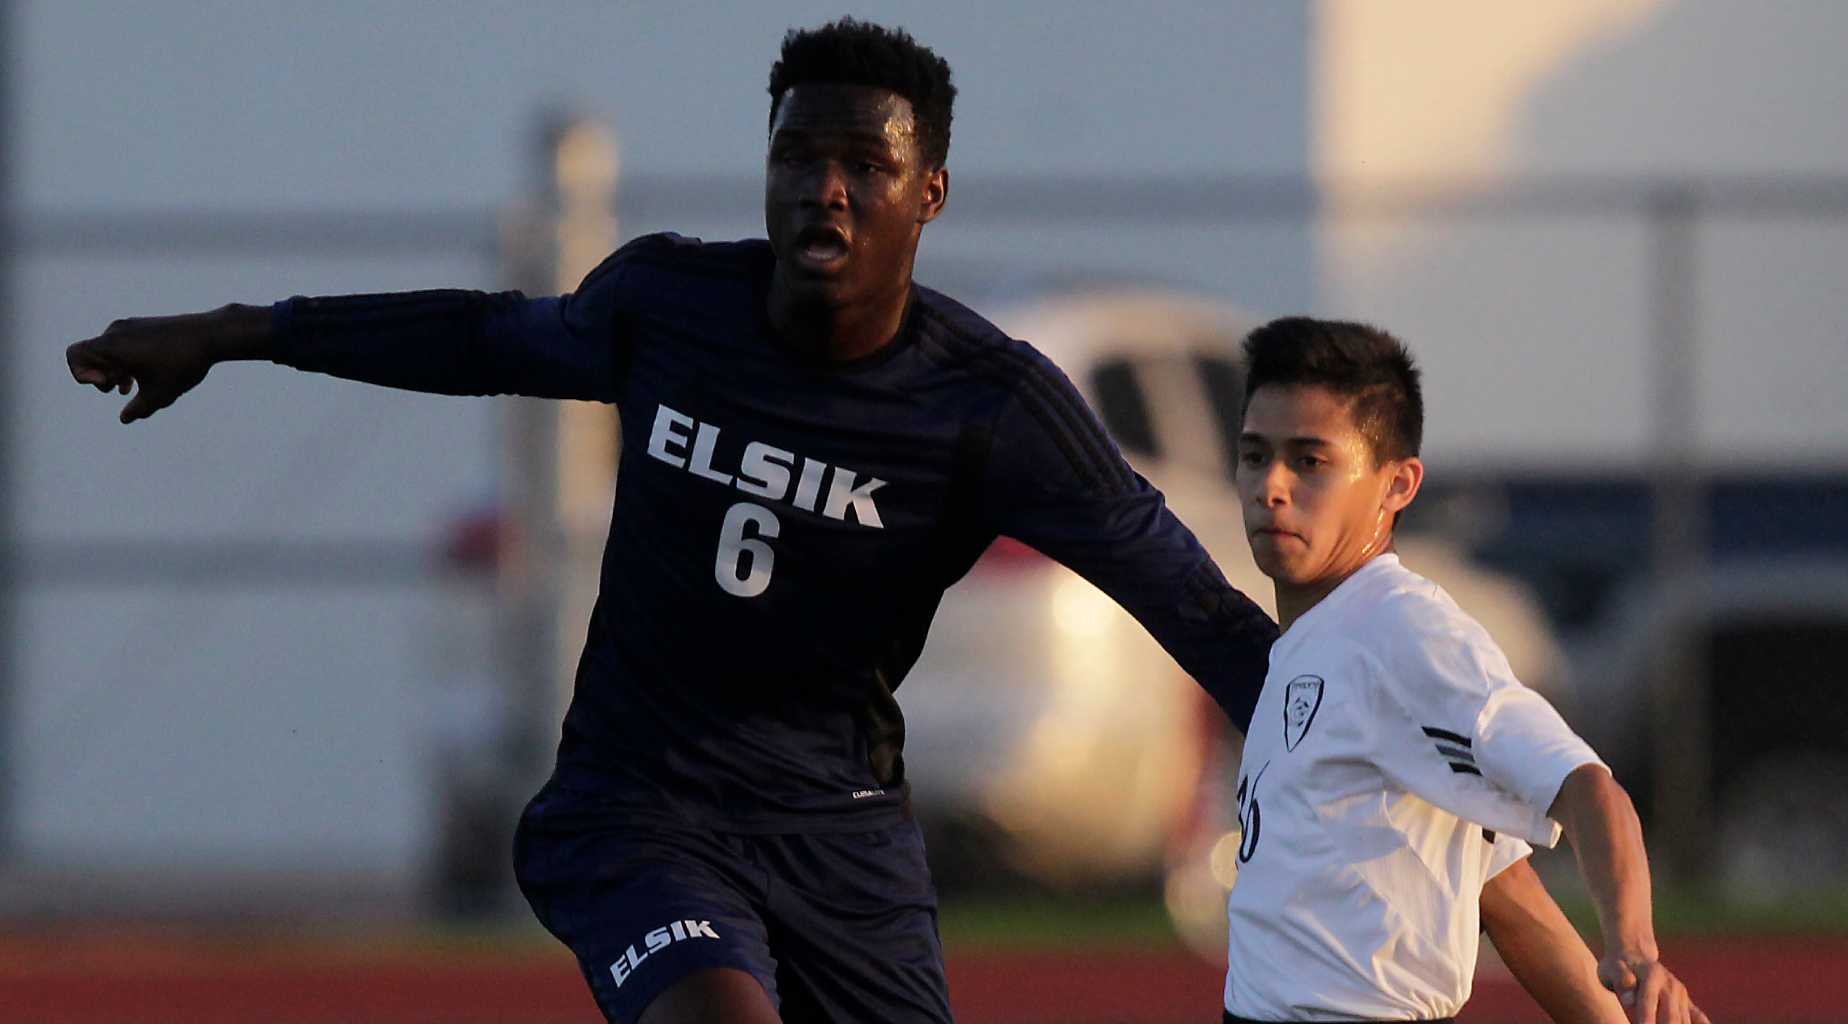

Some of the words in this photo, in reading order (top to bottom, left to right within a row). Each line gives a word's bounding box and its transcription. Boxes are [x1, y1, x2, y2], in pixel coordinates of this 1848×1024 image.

[647, 403, 889, 529] ELSIK
[714, 502, 780, 598] 6
[609, 919, 721, 989] ELSIK
